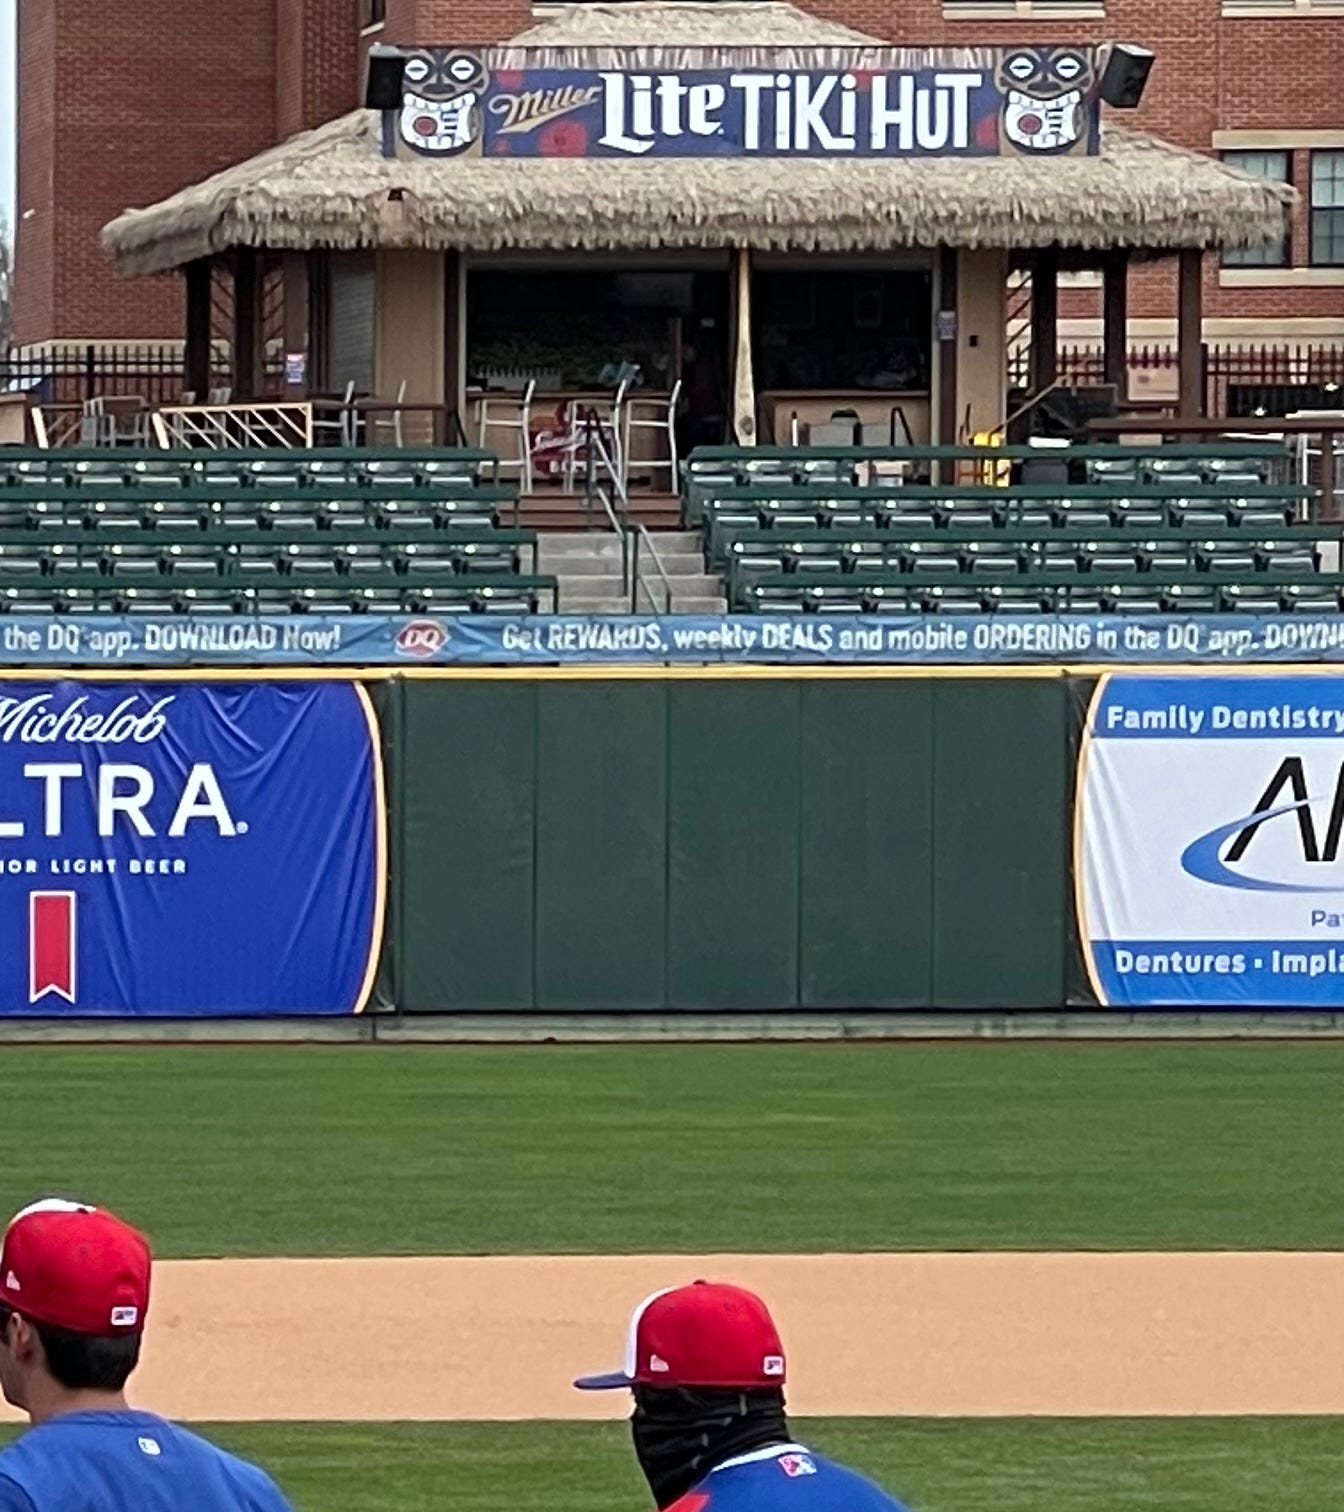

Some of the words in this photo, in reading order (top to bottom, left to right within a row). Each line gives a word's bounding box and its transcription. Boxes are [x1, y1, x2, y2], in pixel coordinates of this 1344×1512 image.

[489, 85, 602, 134] Miller
[598, 73, 726, 154] Lite
[4, 625, 41, 651] the
[89, 629, 139, 657] app.
[145, 625, 276, 651] DOWNLOAD
[282, 625, 340, 651] Now!
[502, 624, 543, 651] Get
[548, 624, 668, 653] REWARDS,
[674, 624, 755, 656] weekly
[763, 624, 831, 651] DEALS
[840, 624, 882, 651] and
[888, 624, 968, 651] mobile
[974, 624, 1090, 651] ORDERING
[1097, 623, 1116, 651] in
[1124, 624, 1160, 651] the
[1208, 629, 1259, 656] app.
[1107, 705, 1205, 733] Family
[1212, 705, 1344, 733] Dentistry
[50, 859, 117, 875] LIGHT
[129, 859, 187, 875] BEER
[1115, 950, 1245, 974] Dentures
